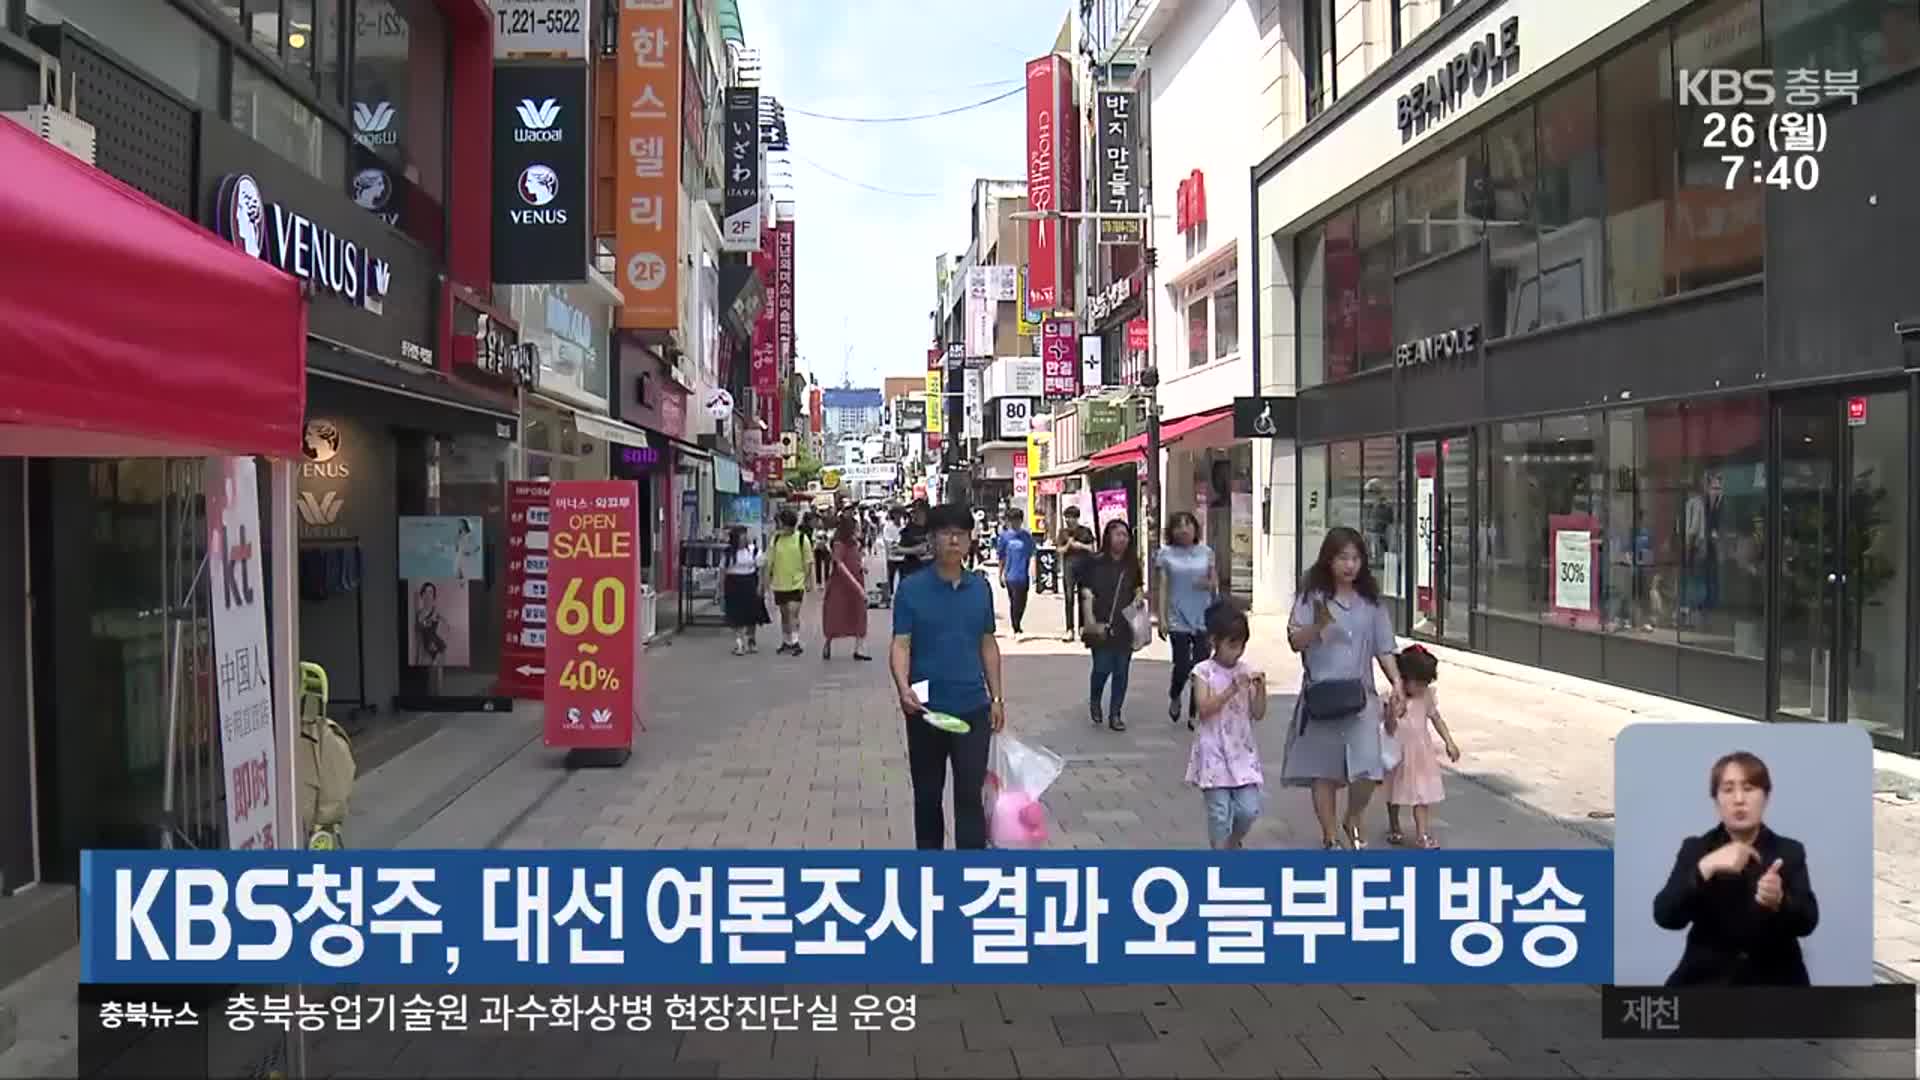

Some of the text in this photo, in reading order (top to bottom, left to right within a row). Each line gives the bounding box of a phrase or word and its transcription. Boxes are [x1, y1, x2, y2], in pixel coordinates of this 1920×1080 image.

[1397, 16, 1519, 130] BEANPOLE
[630, 26, 669, 232] 한스델리
[1106, 95, 1129, 138] 반지
[515, 129, 562, 142] Wacoal
[1107, 147, 1131, 214] 만들기
[510, 209, 567, 224] VENUS
[731, 221, 751, 235] 2F
[274, 202, 358, 299] VENUS
[633, 261, 661, 281] 2F
[1396, 324, 1475, 368] BEANPOLE
[1006, 402, 1027, 419] 80
[569, 514, 616, 530] OPEN
[553, 532, 630, 558] SALE
[222, 524, 254, 610] kt
[1560, 561, 1585, 583] 30%
[556, 576, 625, 635] 60
[220, 644, 268, 701] 中国人
[559, 660, 620, 690] 40%
